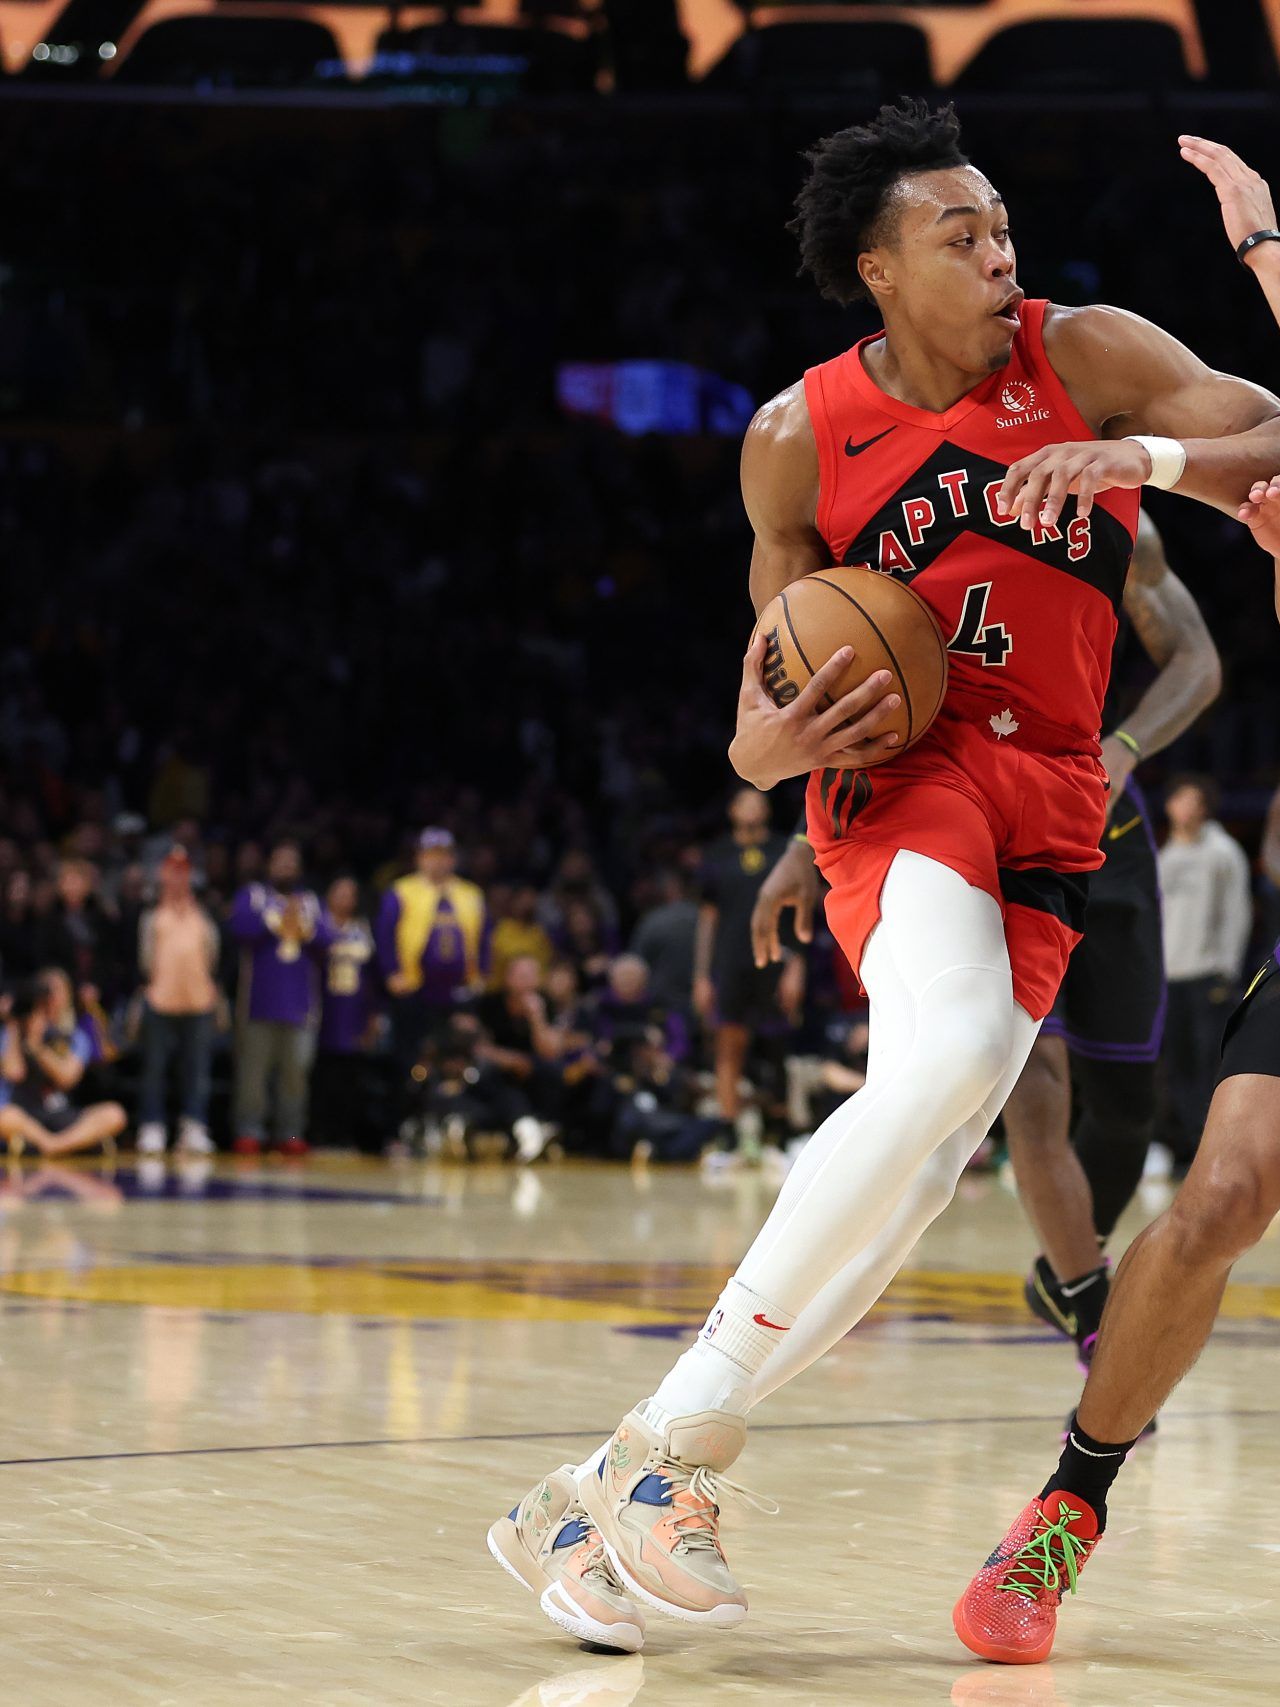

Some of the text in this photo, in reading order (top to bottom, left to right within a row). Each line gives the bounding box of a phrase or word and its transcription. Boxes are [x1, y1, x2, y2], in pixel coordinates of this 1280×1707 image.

[996, 408, 1051, 429] Sun Life
[852, 468, 1092, 574] APTORS
[946, 581, 1013, 667] 4
